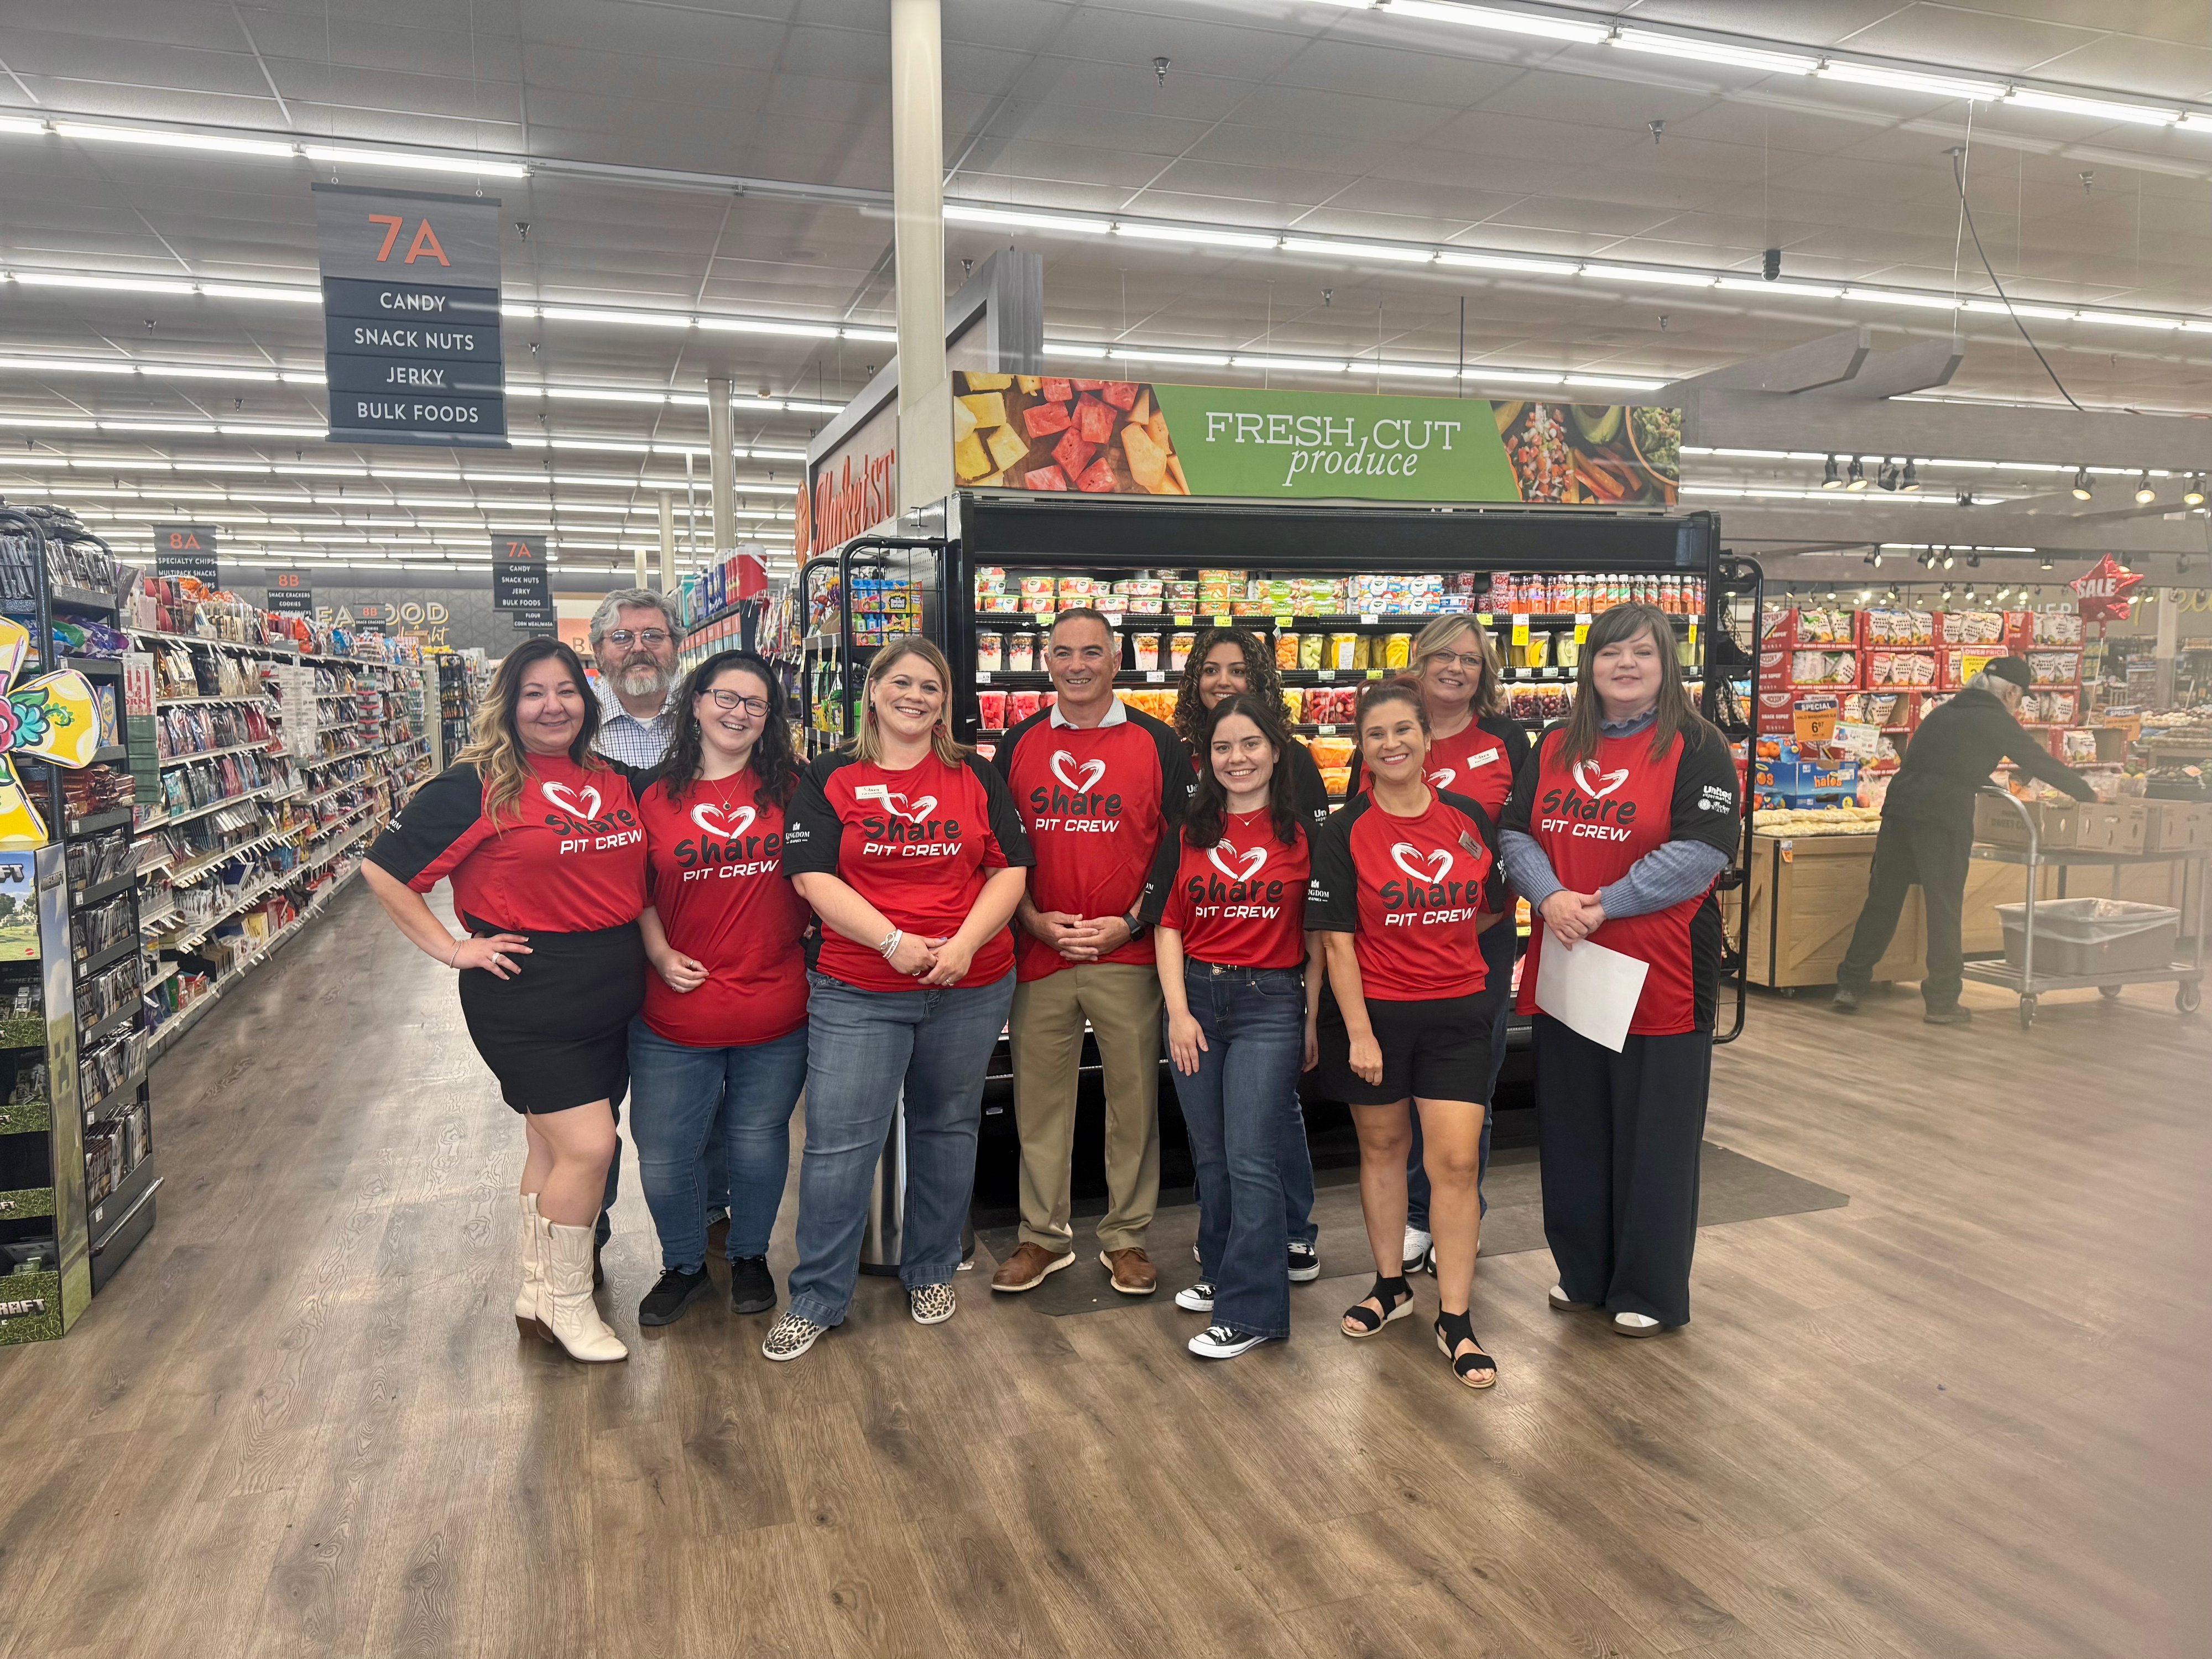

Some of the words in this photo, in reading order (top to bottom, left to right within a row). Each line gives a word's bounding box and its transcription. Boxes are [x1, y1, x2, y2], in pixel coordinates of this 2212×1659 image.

[369, 213, 451, 267] 7A
[380, 293, 446, 312] CANDY
[354, 328, 418, 348] SNACK
[426, 332, 474, 351] NUTS
[386, 367, 444, 385] JERKY
[357, 402, 406, 420] BULK
[414, 404, 479, 423] FOODS
[1206, 411, 1355, 447] FRESH
[1373, 419, 1461, 450] CUT
[1282, 436, 1418, 487] produce
[812, 454, 869, 558] Market
[170, 533, 201, 550] 8A
[506, 542, 531, 558] 7A
[279, 575, 299, 587] 8B
[2078, 578, 2117, 598] SALE
[363, 607, 378, 617] 8B
[1802, 702, 1831, 711] SPECIAL
[1814, 774, 1842, 787] halos
[1030, 784, 1123, 817] Share
[1703, 785, 1732, 801] United
[1541, 788, 1637, 825] Share
[545, 809, 637, 836] Share
[863, 814, 962, 843] Share
[1035, 818, 1061, 831] PIT
[1064, 819, 1119, 832] CREW
[1541, 818, 1569, 833] PIT
[1572, 823, 1631, 842] CREW
[560, 839, 589, 854] PIT
[596, 828, 642, 850] CREW
[674, 833, 782, 868] Share
[863, 842, 897, 856] PIT
[902, 843, 962, 856] CREW
[684, 868, 713, 881] PIT
[719, 859, 779, 878] CREW
[1188, 873, 1284, 903] Share
[1380, 878, 1478, 910] Share
[1196, 906, 1220, 918] PIT
[1223, 905, 1280, 919] CREW
[1385, 912, 1417, 926] PIT
[1422, 906, 1477, 924] CREW
